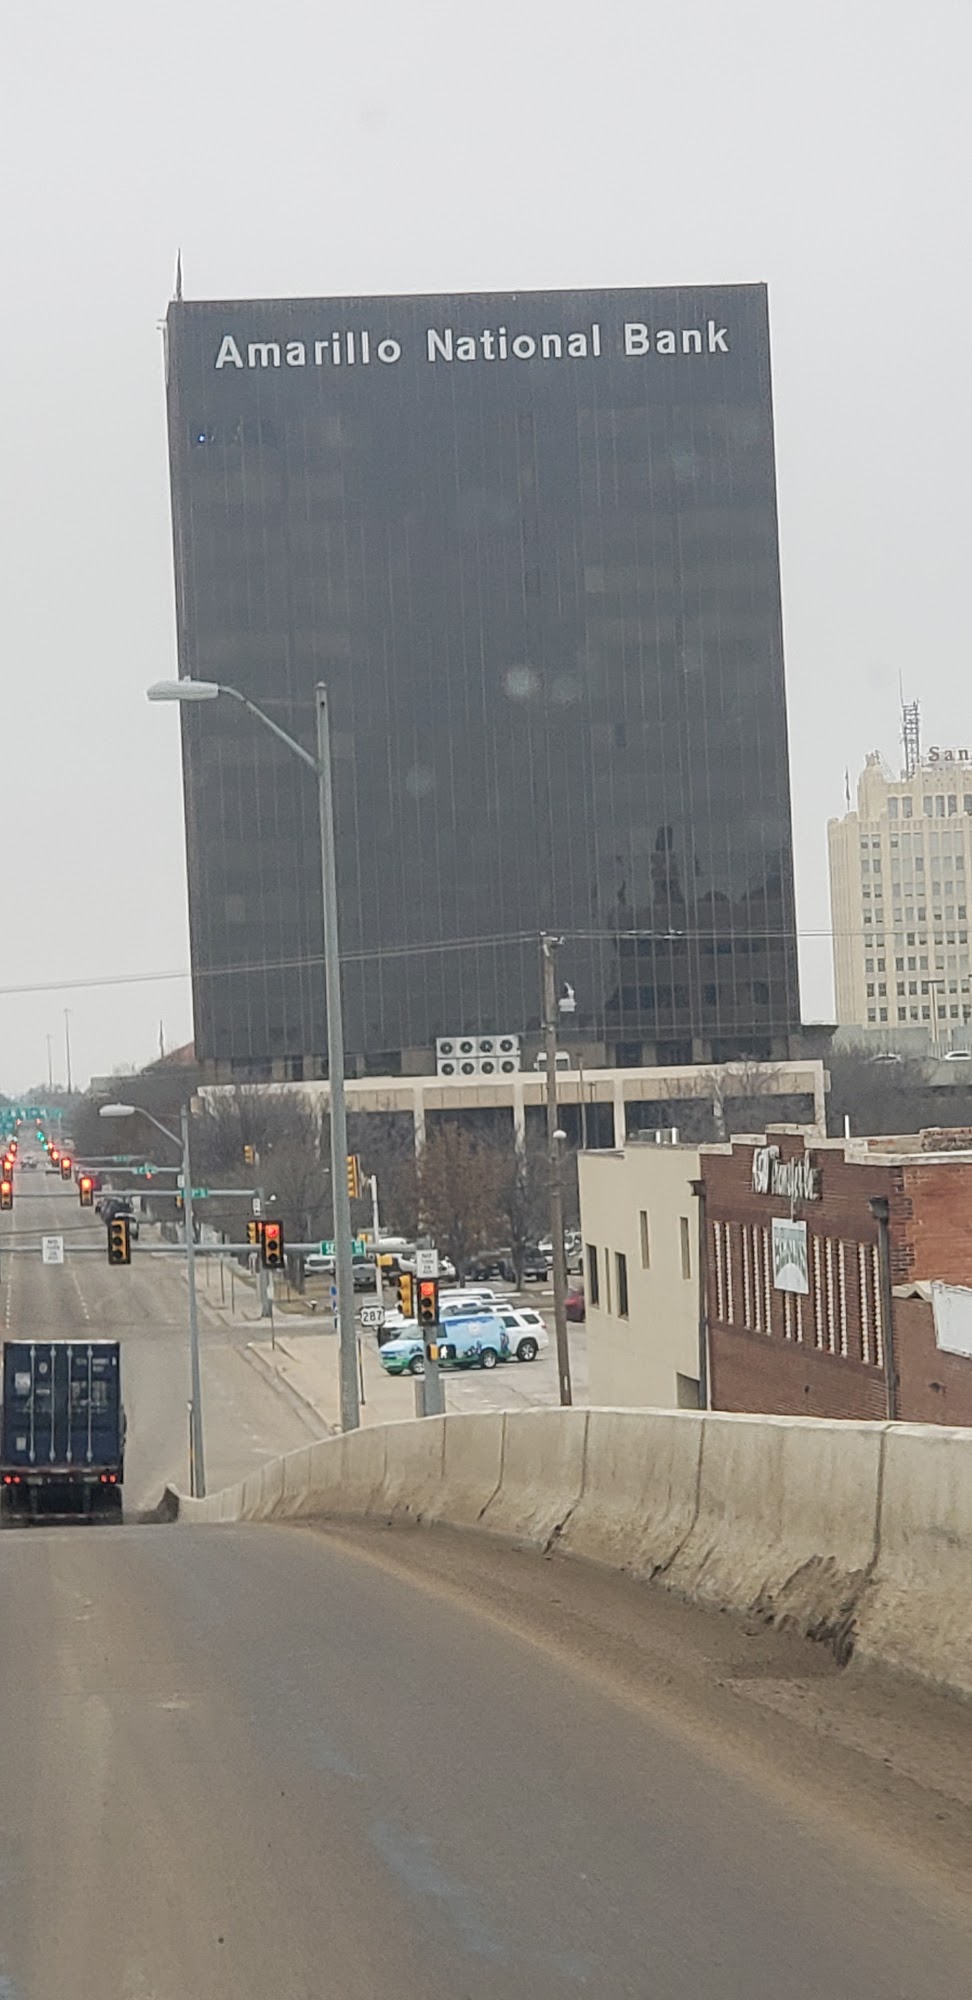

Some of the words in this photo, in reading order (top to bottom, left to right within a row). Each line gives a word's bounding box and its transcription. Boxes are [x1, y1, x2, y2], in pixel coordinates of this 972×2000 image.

[215, 331, 401, 369] Amarillo
[426, 324, 601, 362] National
[623, 320, 730, 357] Bank
[363, 1310, 382, 1322] 287
